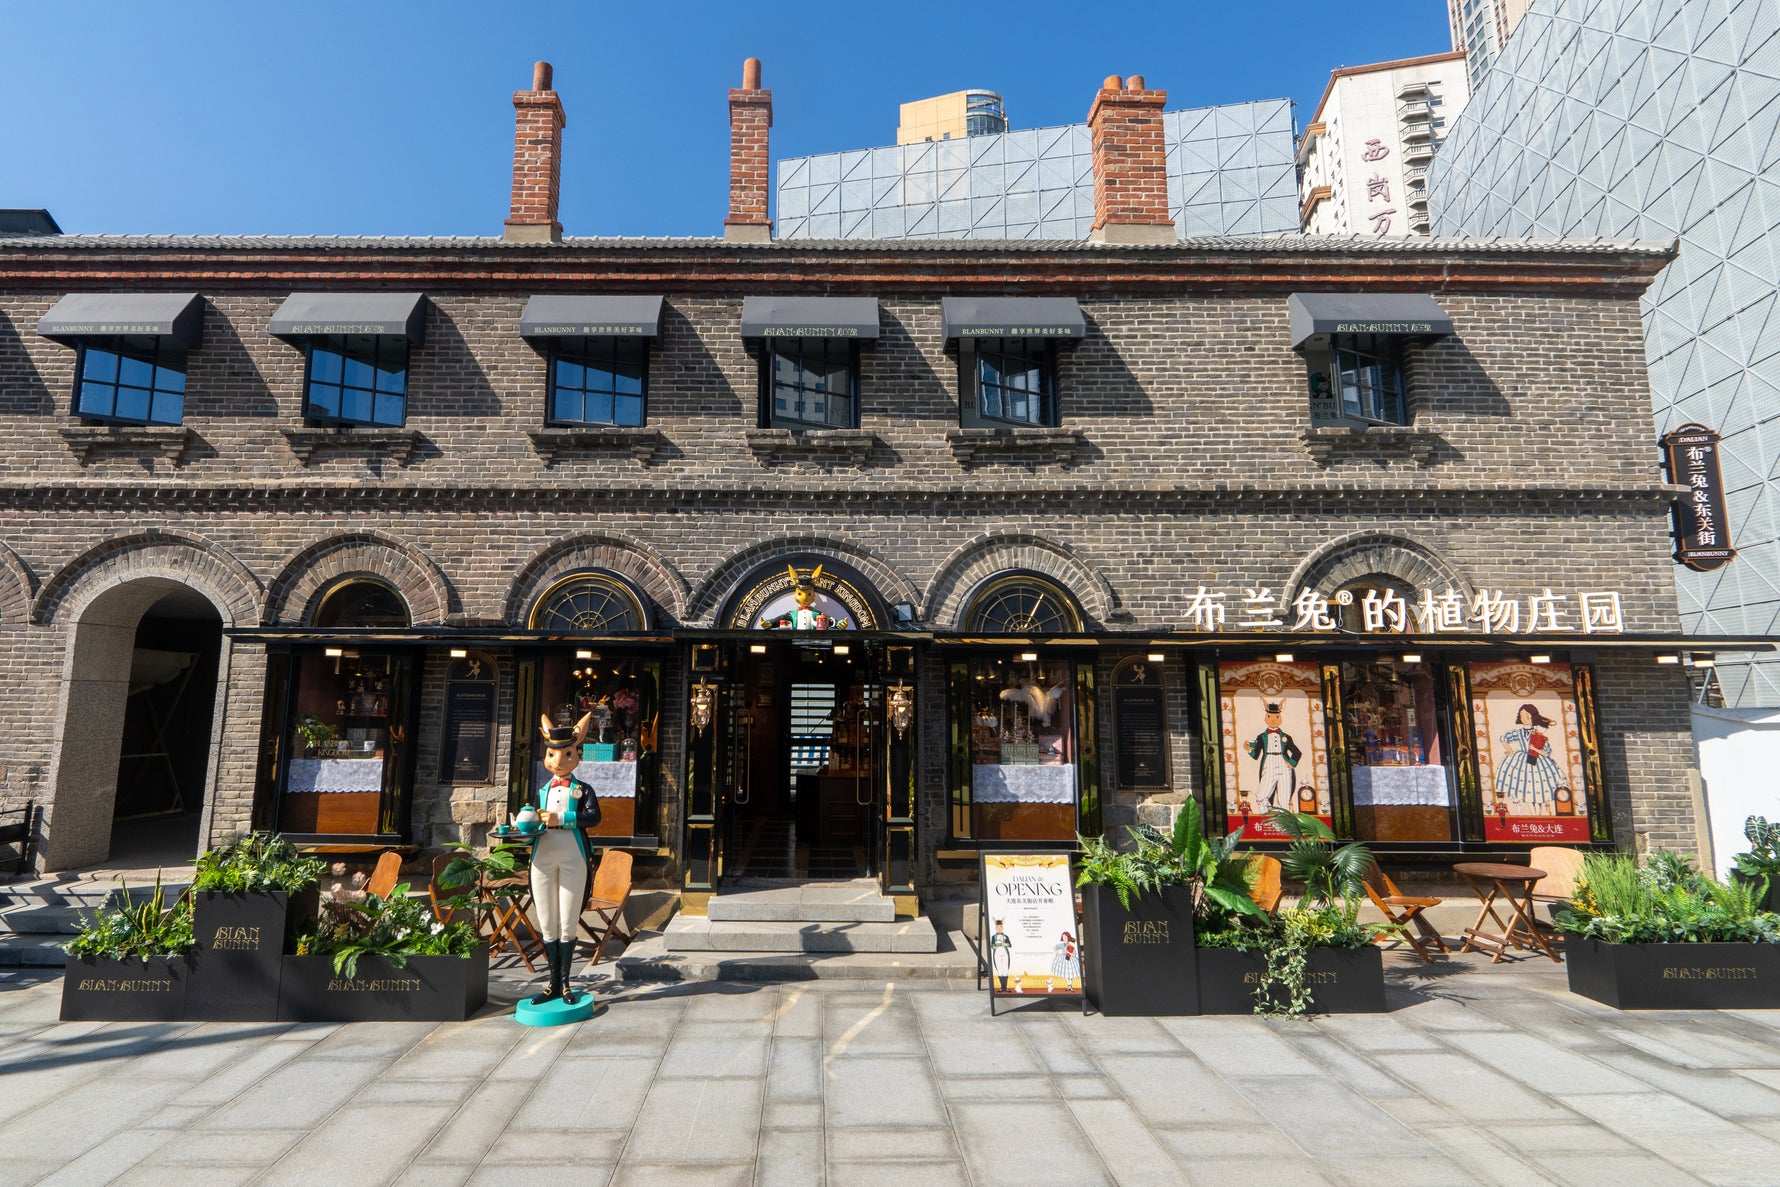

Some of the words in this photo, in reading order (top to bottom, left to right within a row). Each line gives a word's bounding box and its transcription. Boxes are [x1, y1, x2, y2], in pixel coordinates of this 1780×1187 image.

[1511, 823, 1563, 834] 布兰兔&大连
[995, 882, 1063, 896] OPENING
